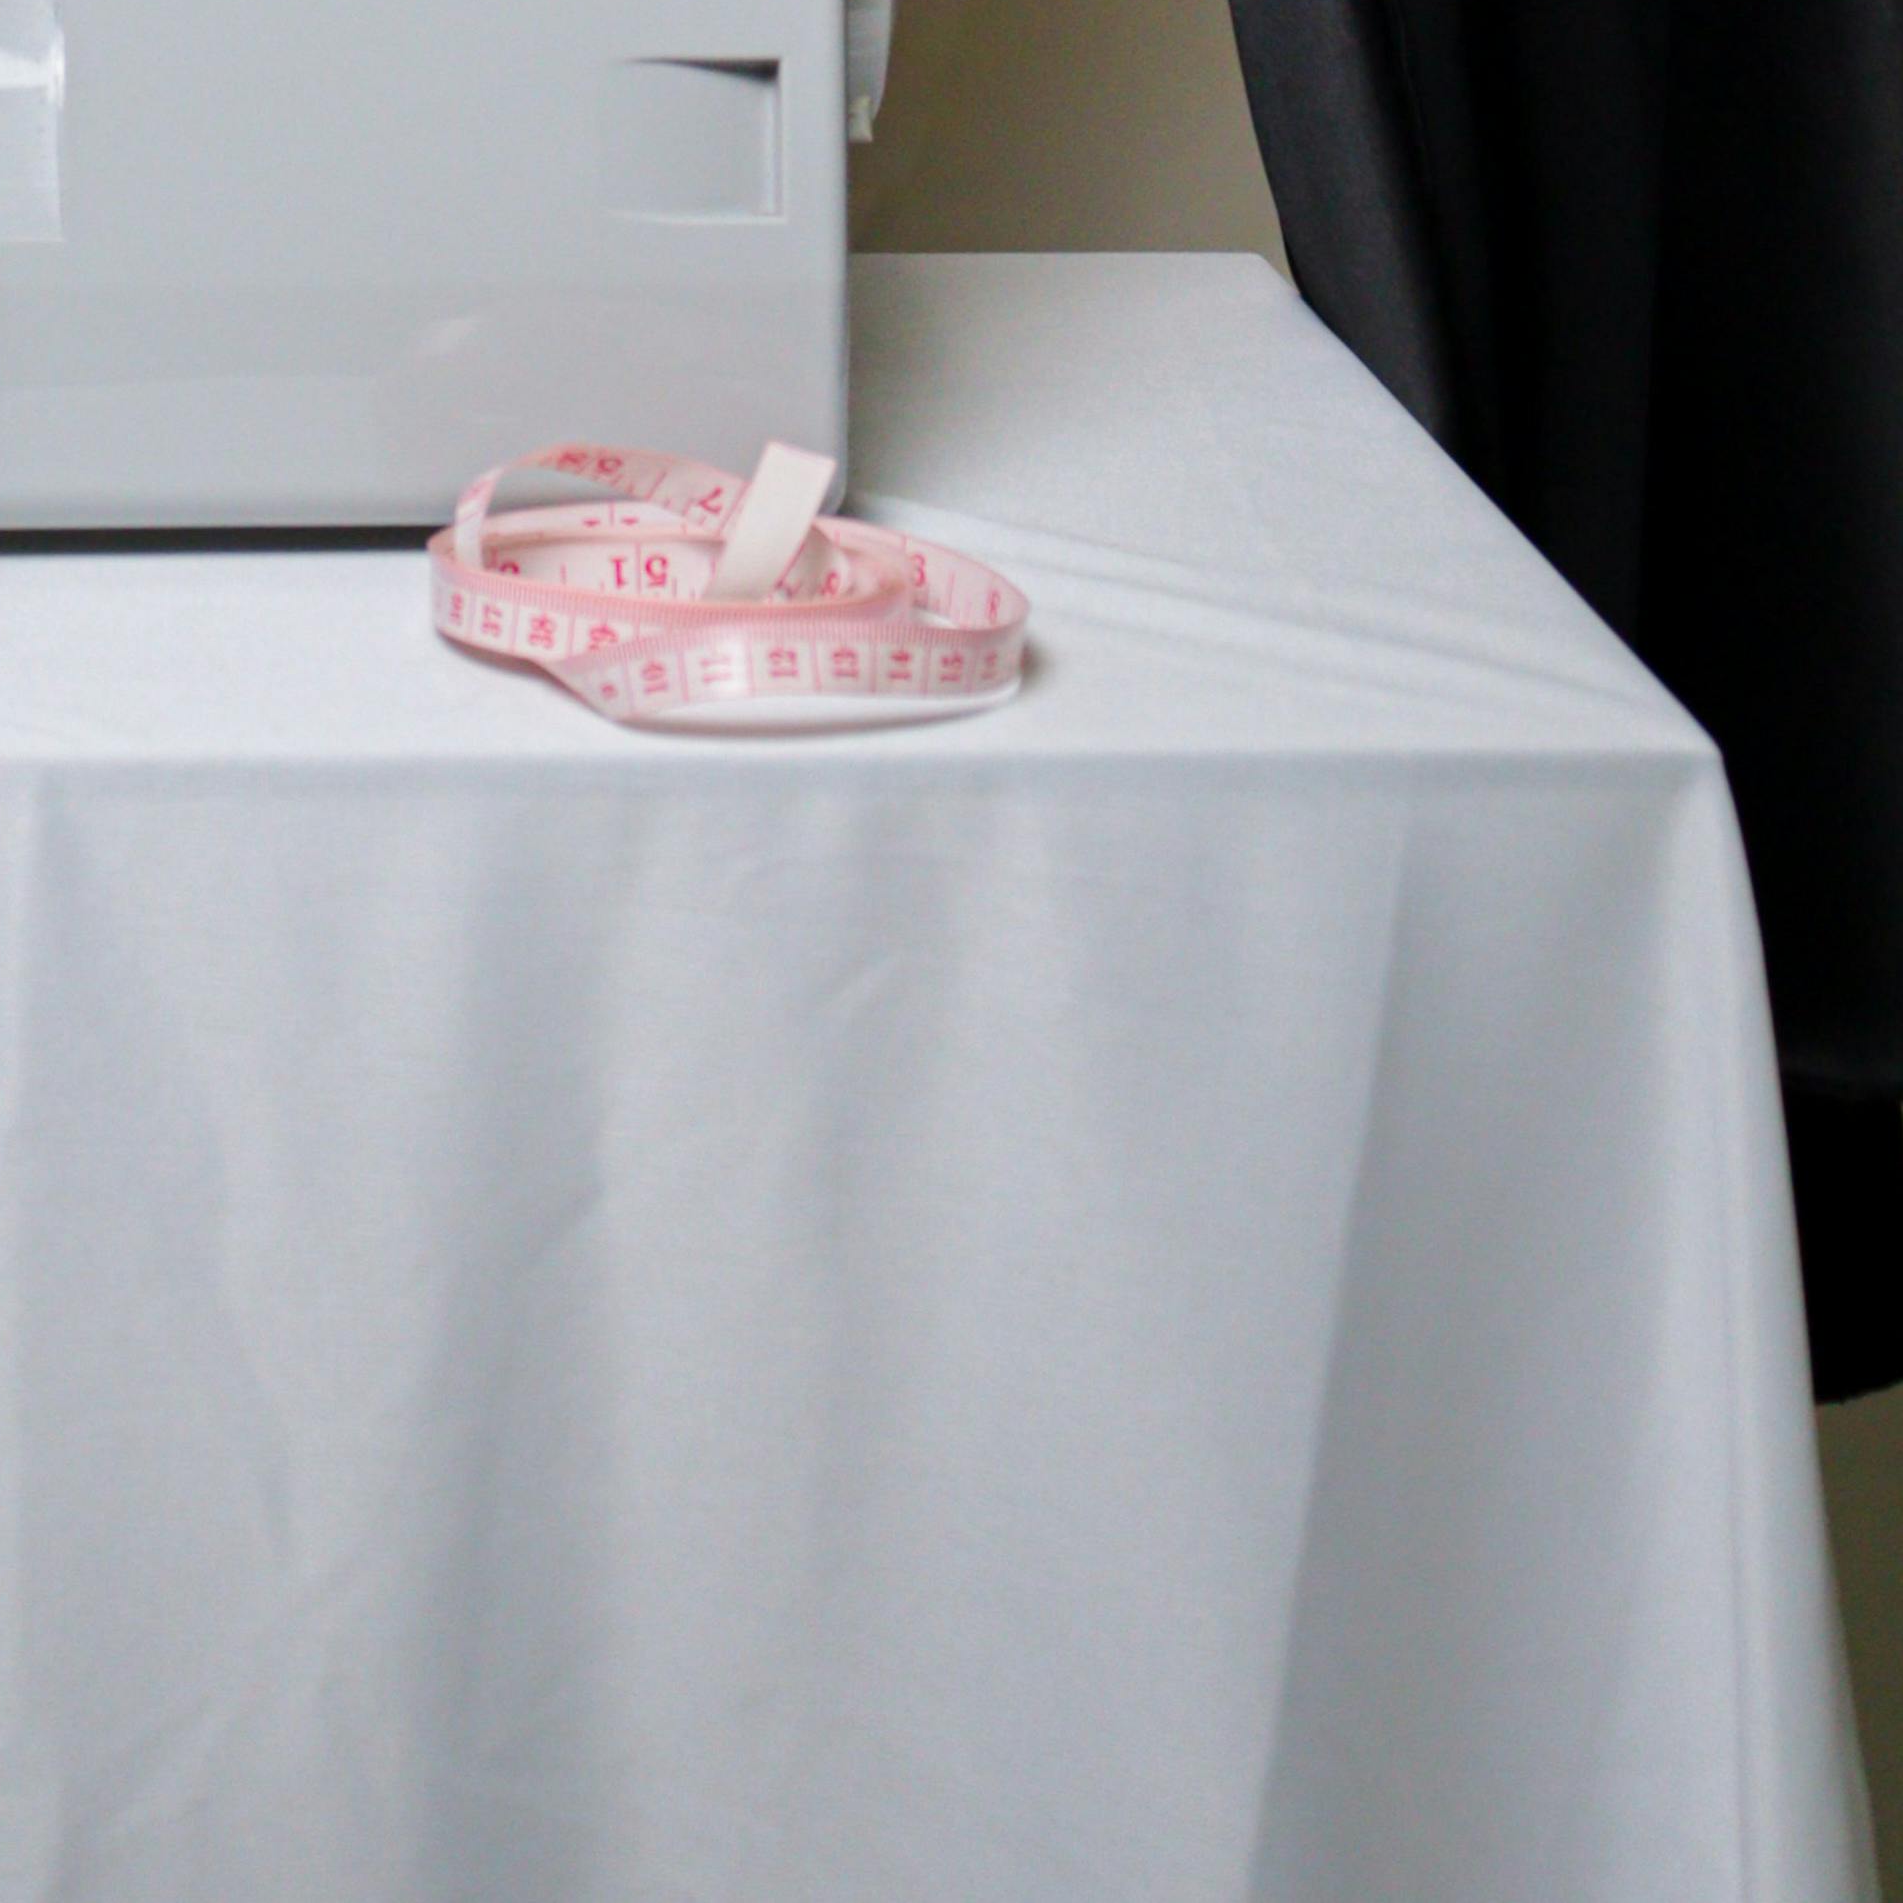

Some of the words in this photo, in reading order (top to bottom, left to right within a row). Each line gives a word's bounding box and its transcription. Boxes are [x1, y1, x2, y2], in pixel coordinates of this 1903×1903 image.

[481, 604, 503, 638] 37
[529, 612, 557, 649] 38
[642, 661, 669, 694] 10
[699, 654, 732, 685] 11
[768, 648, 800, 679] 12
[832, 648, 860, 679] 13
[887, 650, 913, 680] 14
